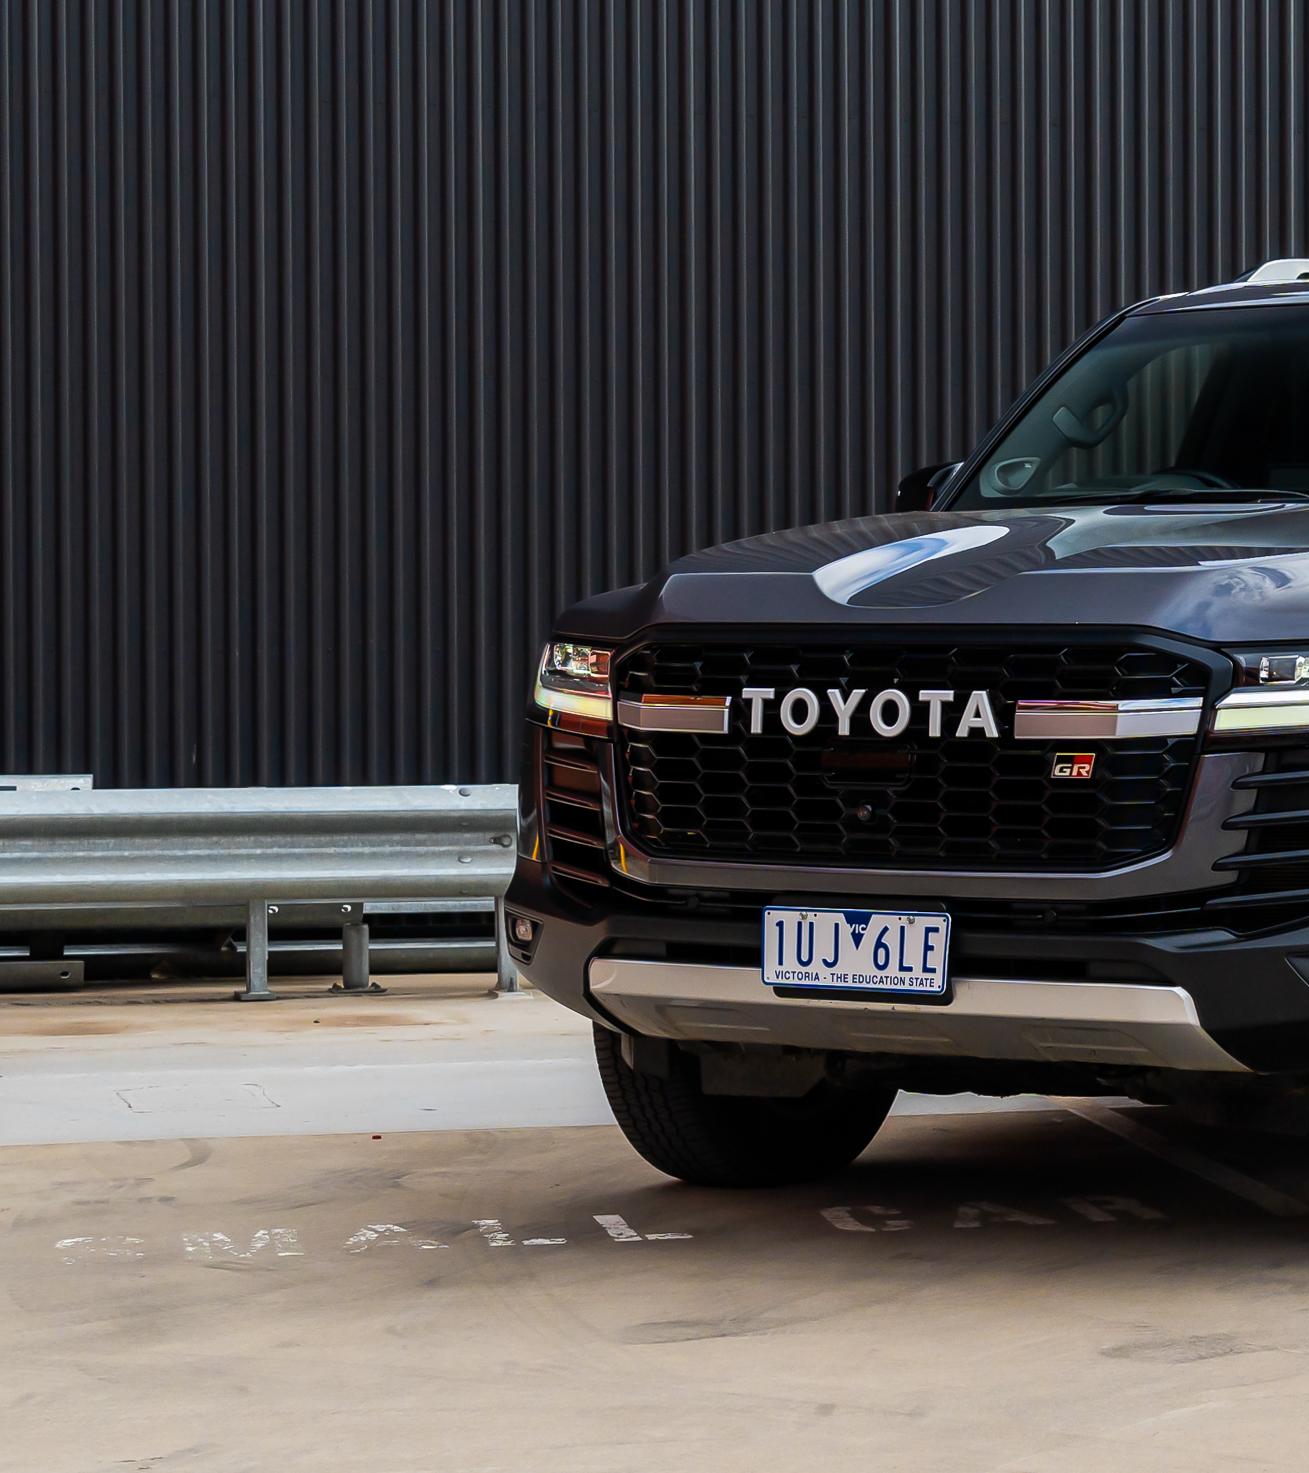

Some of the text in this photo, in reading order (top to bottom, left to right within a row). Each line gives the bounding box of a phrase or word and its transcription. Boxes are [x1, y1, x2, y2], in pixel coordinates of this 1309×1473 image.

[741, 687, 999, 738] TOYOTA
[1054, 763, 1090, 776] GR
[848, 923, 867, 934] VIC
[775, 919, 940, 974] 1UJ 6LE
[774, 970, 820, 982] VICTORIA
[830, 972, 849, 984] THE
[851, 973, 906, 986] EDUCATION
[908, 976, 935, 988] STATE
[54, 1195, 1168, 1264] SMALL CAR
